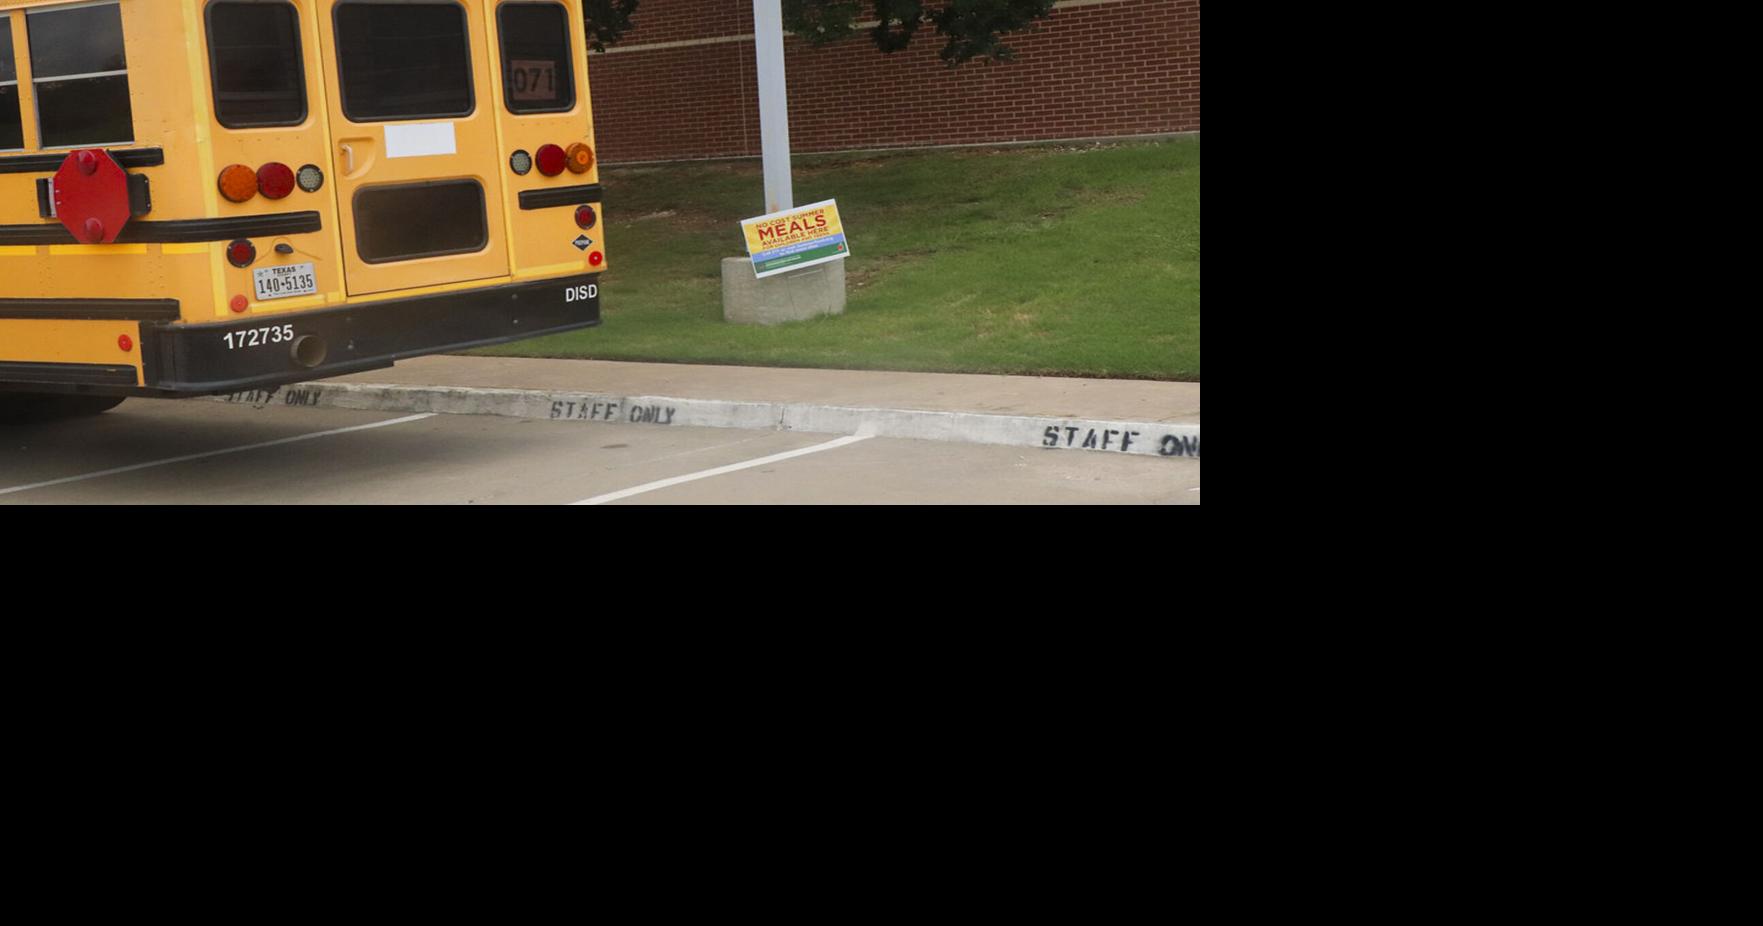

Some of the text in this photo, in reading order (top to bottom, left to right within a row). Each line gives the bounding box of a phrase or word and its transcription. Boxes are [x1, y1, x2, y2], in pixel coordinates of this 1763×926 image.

[513, 67, 553, 93] 071
[758, 214, 827, 241] MEALS
[770, 216, 790, 226] COST
[792, 208, 825, 220] SUMMER
[762, 232, 807, 247] AVAILABLE
[808, 226, 829, 236] HERE
[272, 266, 296, 275] TEXAS
[565, 283, 598, 302] DISD
[223, 324, 294, 350] 172735
[285, 389, 322, 406] ONLY
[550, 400, 676, 424] STAFF ONLY
[1043, 425, 1200, 457] STAFF ON
